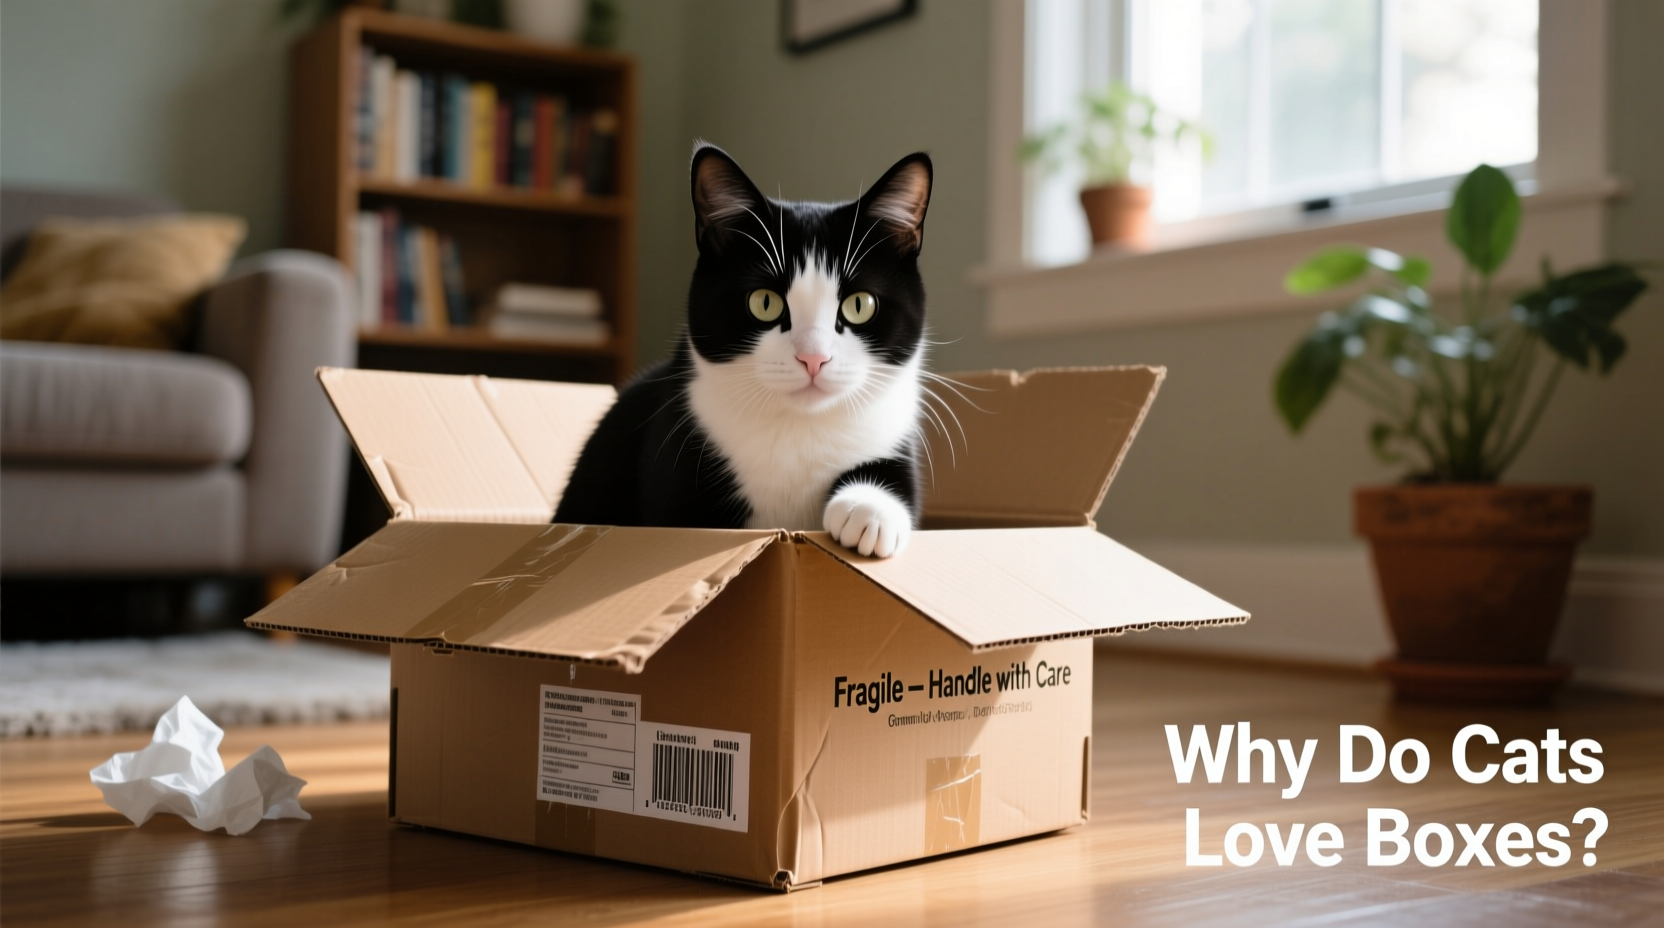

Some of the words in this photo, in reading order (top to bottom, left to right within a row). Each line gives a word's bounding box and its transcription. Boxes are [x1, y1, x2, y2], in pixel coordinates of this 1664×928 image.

[834, 671, 904, 713] Fragile
[928, 665, 992, 699] Handle
[996, 660, 1031, 693] with
[1036, 660, 1072, 688] Care
